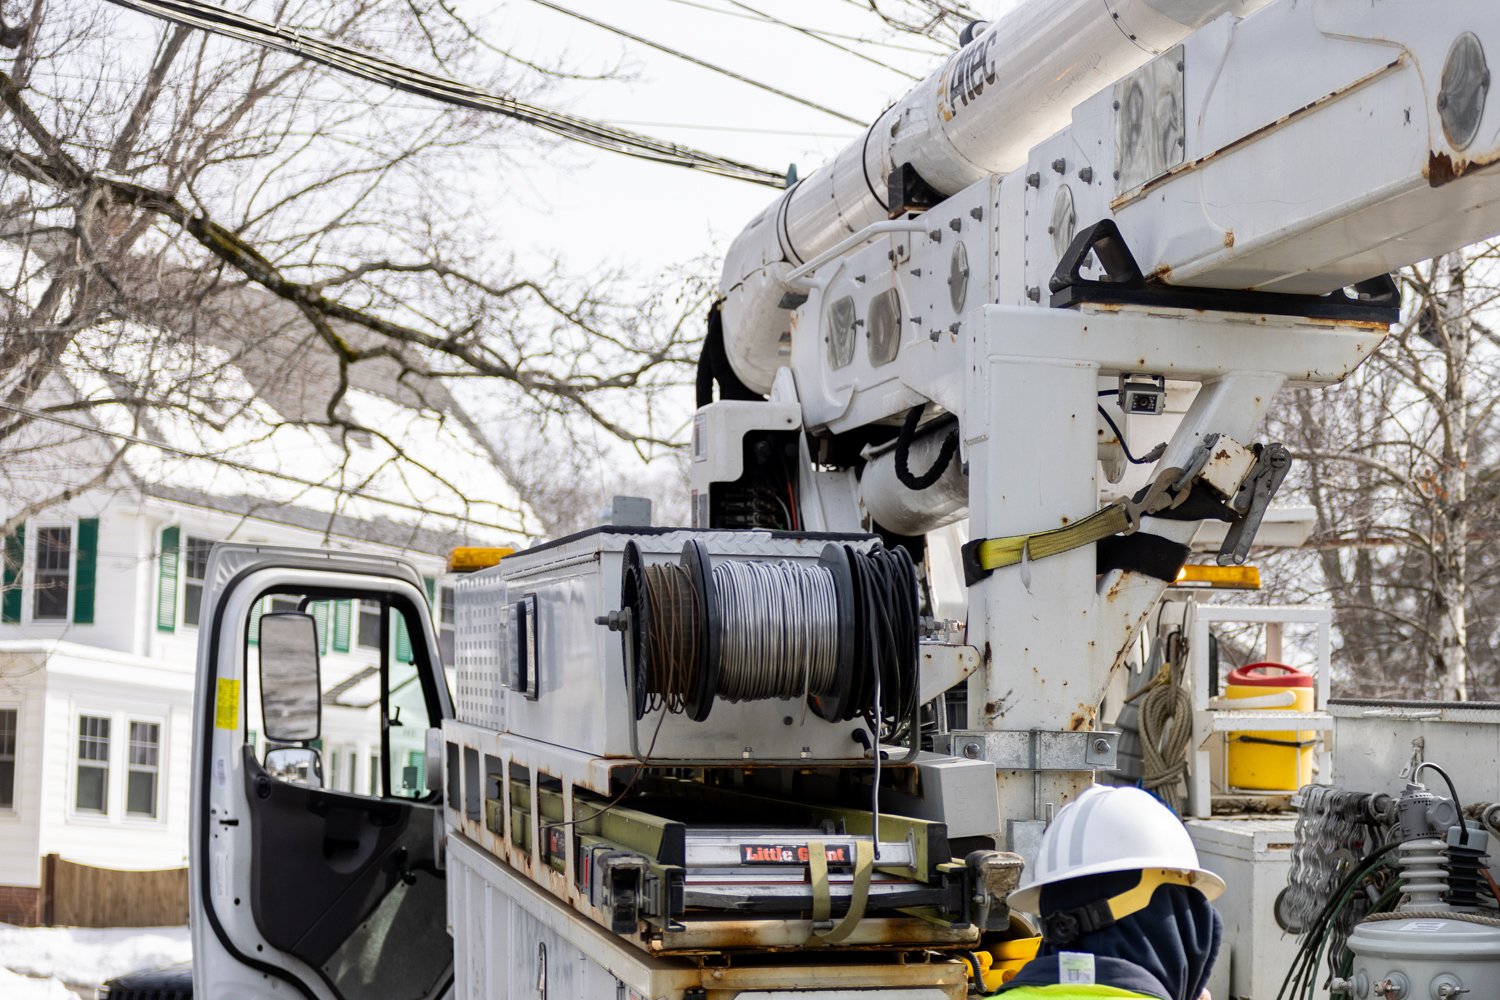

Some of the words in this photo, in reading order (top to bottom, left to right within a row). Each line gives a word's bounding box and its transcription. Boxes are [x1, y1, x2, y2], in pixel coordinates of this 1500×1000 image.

[950, 30, 998, 117] Altec
[745, 846, 793, 862] Little
[797, 846, 845, 862] Gnt
